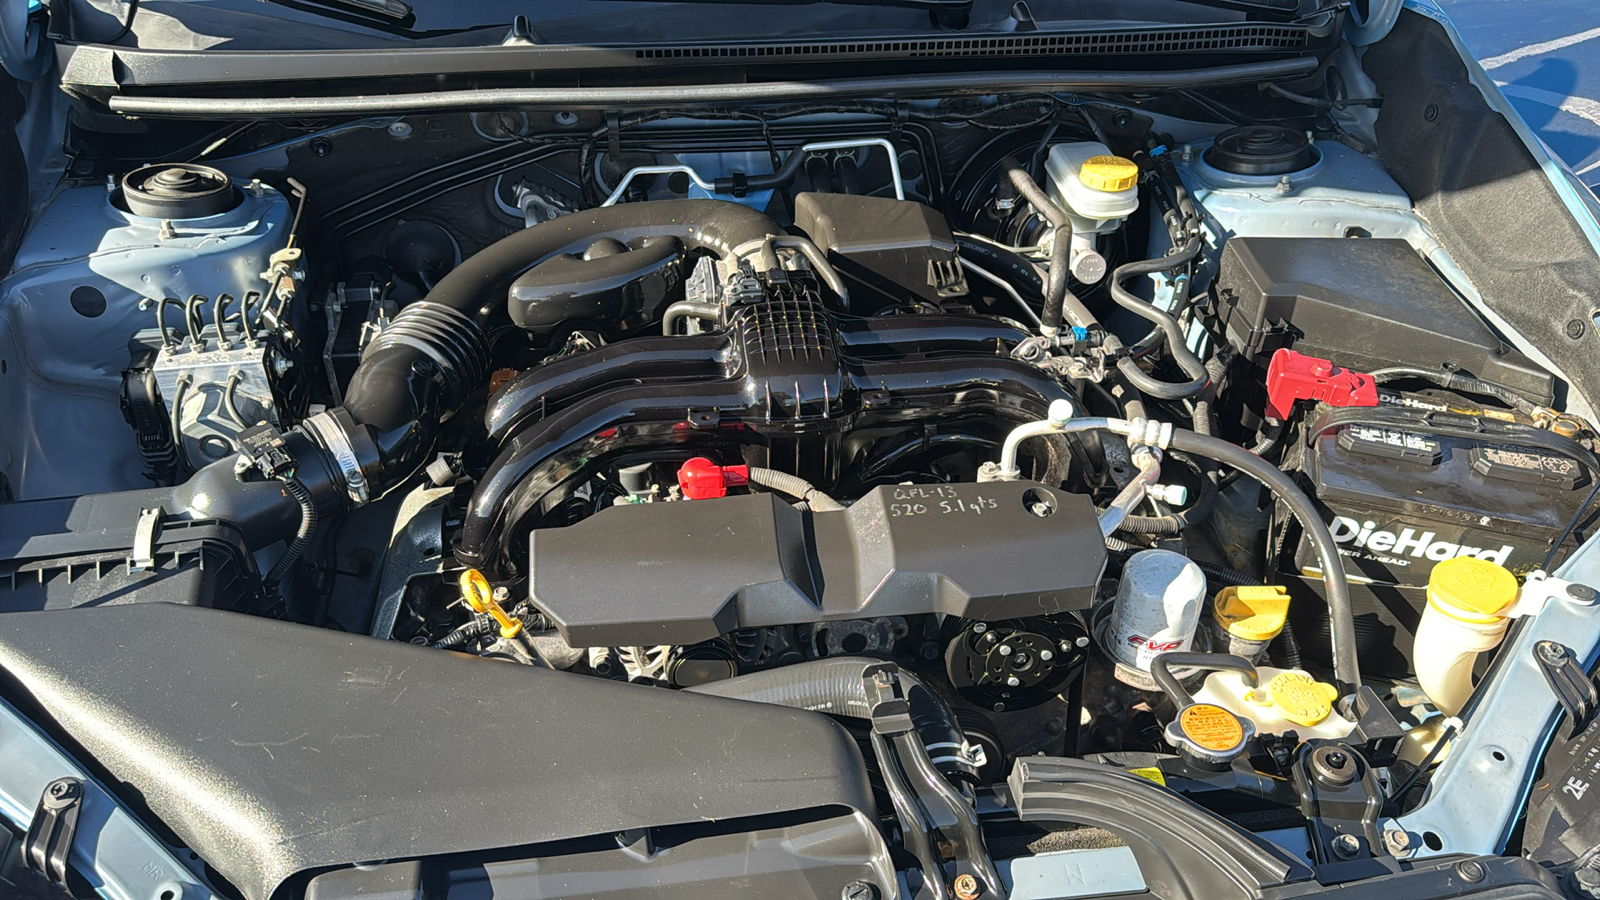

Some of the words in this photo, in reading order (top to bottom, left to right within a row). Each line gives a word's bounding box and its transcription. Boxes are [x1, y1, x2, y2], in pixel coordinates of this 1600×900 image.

[1380, 394, 1447, 412] DieHard
[890, 503, 928, 517] 520
[1329, 515, 1514, 567] DieHard
[1127, 634, 1184, 652] FVP
[1562, 776, 1590, 801] 2E
